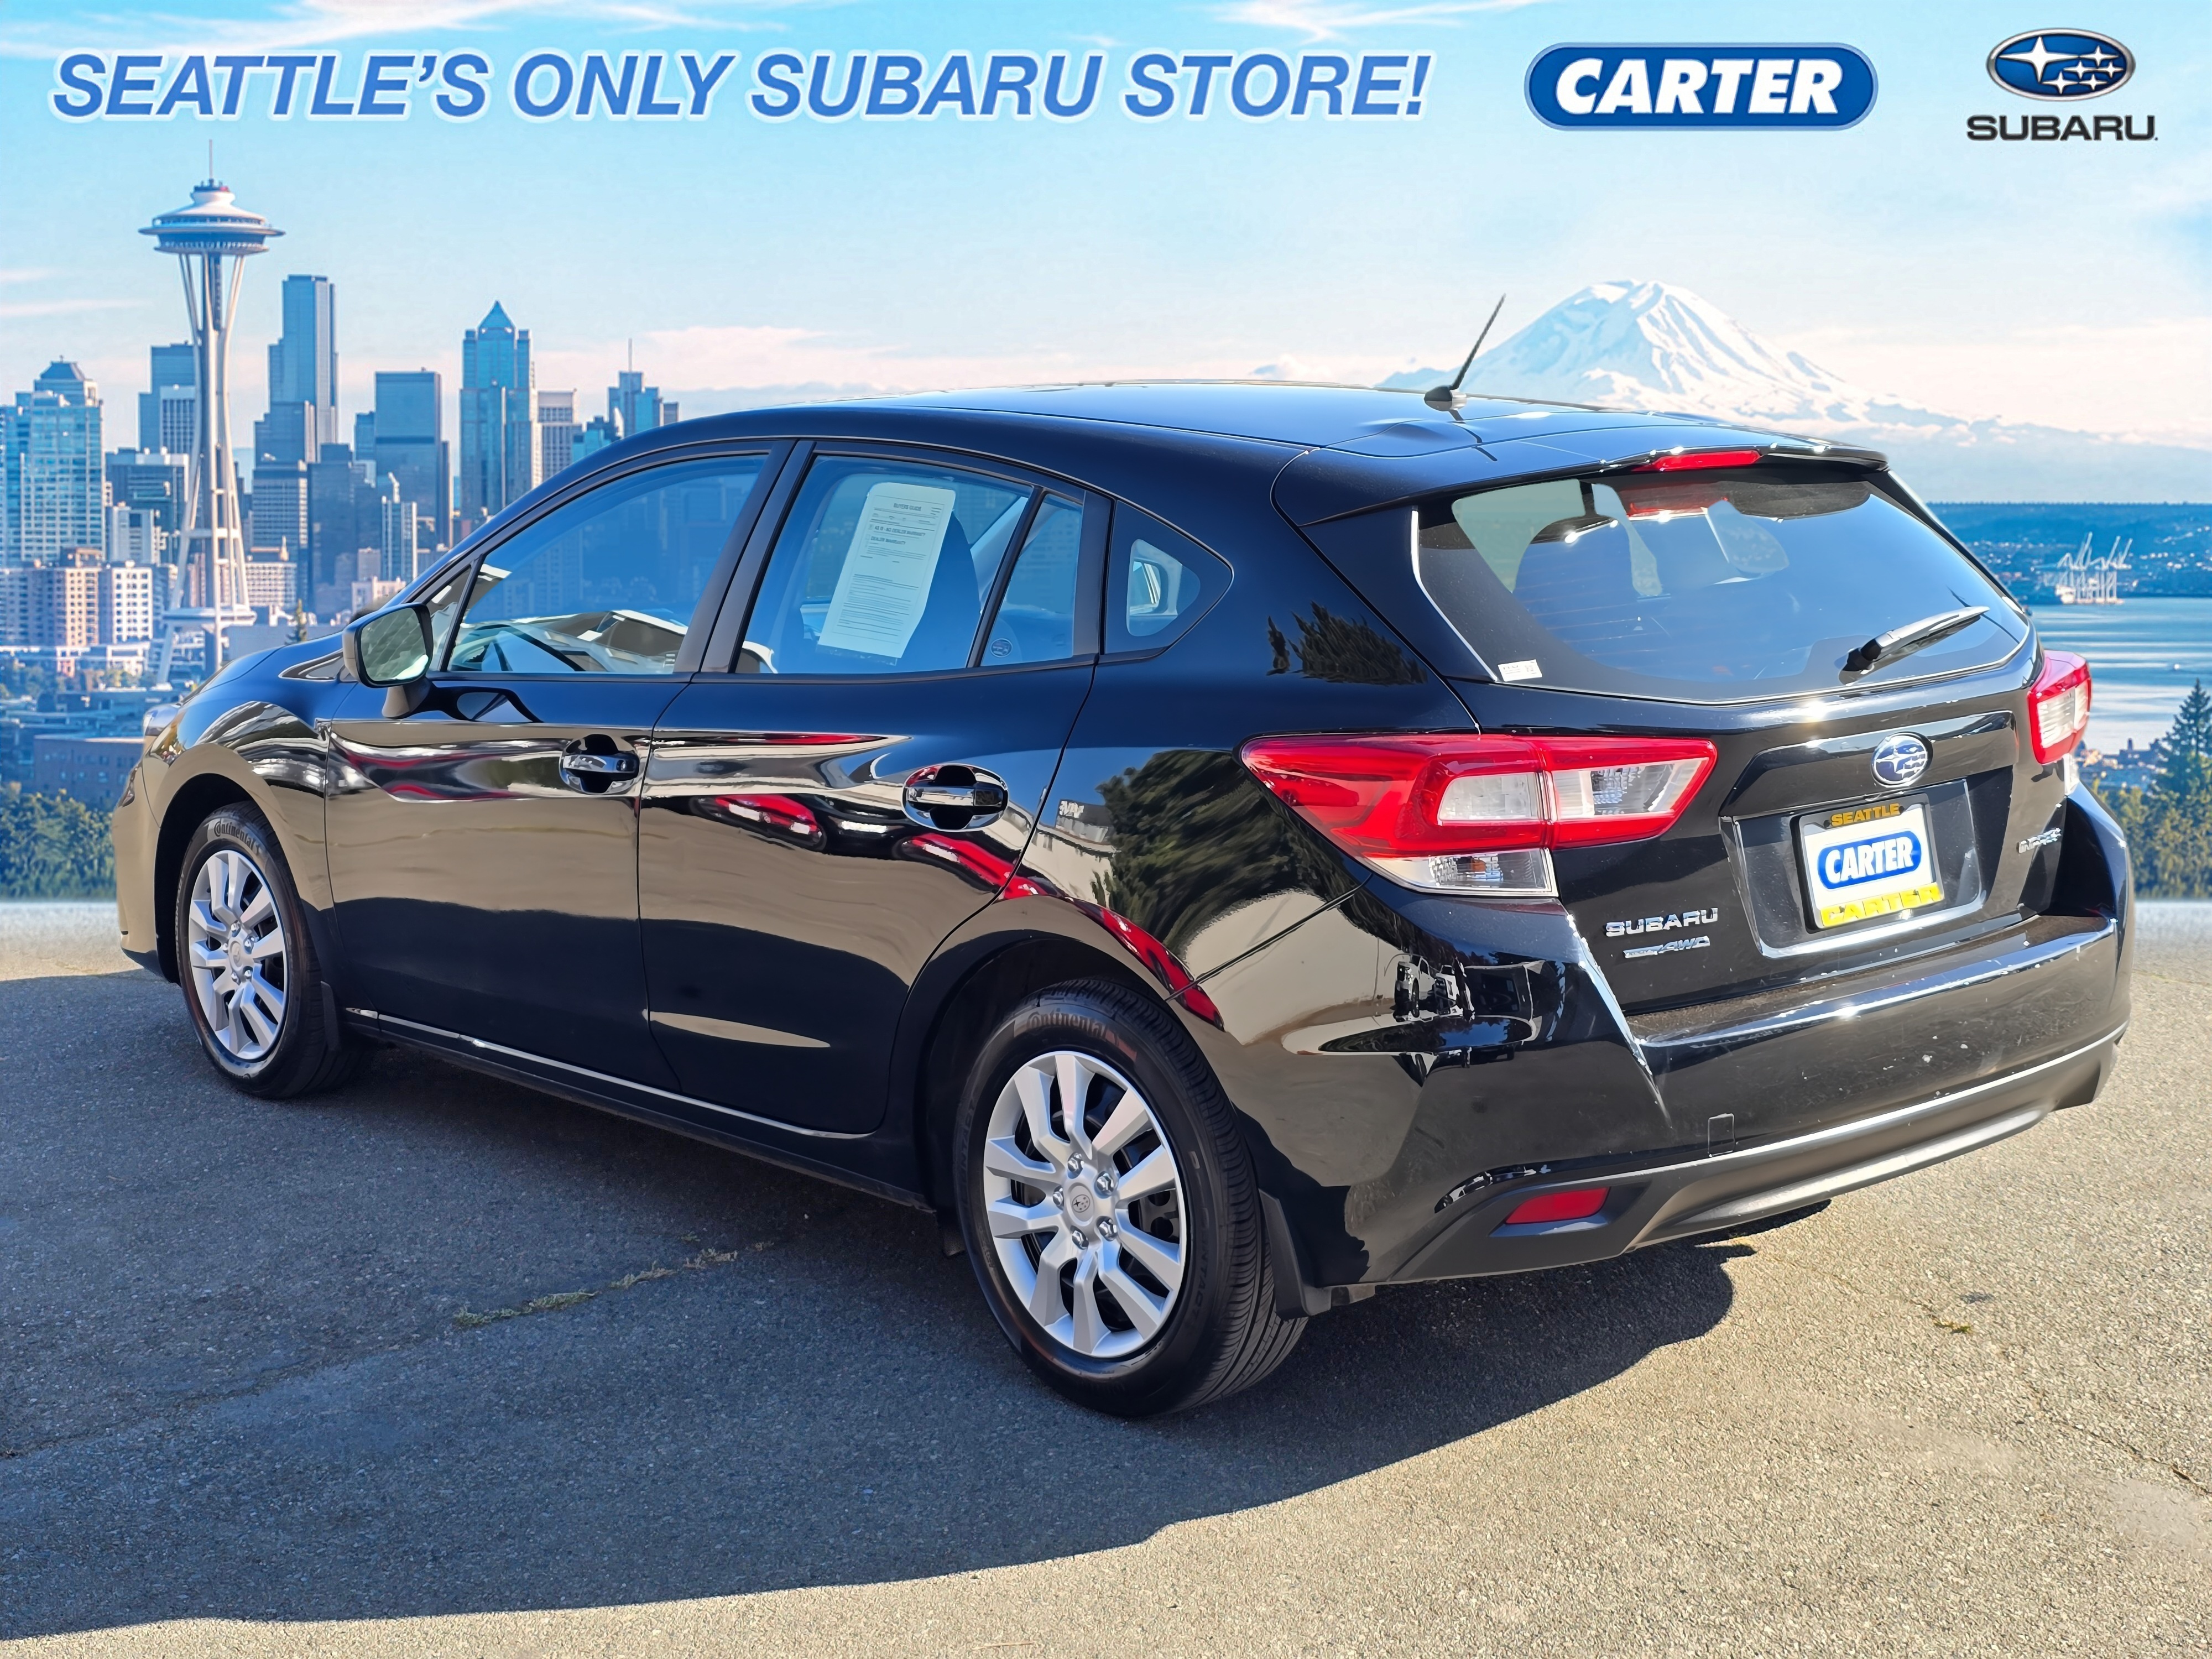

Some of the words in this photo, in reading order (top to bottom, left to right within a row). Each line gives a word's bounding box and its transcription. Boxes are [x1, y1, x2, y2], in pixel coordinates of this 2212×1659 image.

[1831, 803, 1900, 827] SEATTLE
[213, 821, 256, 851] Continental
[1825, 836, 1914, 884] CARTER
[1822, 886, 1940, 926] CARTER
[1605, 907, 1719, 937] SUBARU
[1026, 1007, 1107, 1039] Continental
